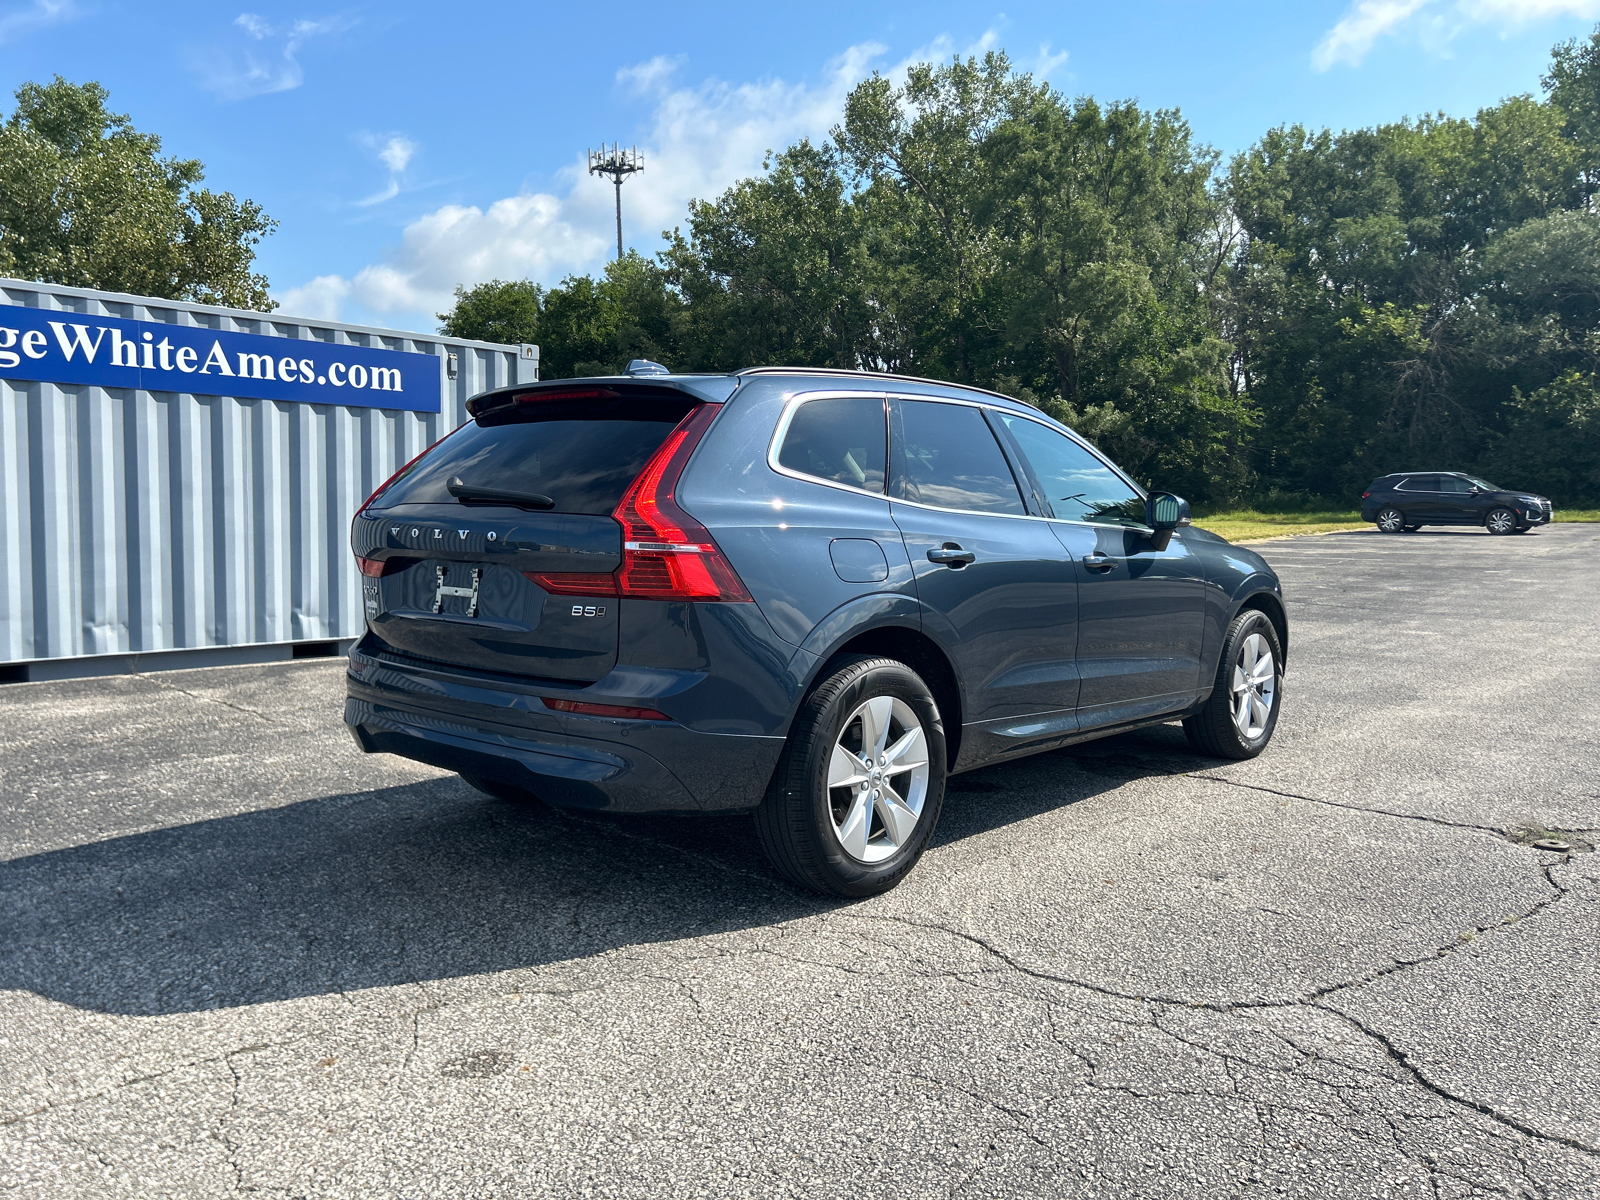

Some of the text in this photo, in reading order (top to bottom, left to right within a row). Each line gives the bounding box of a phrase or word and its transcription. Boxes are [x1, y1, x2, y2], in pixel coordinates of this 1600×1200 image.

[0, 321, 404, 392] geWhiteAmes.com
[391, 527, 497, 542] VOLVO
[876, 859, 912, 885] ZERO
